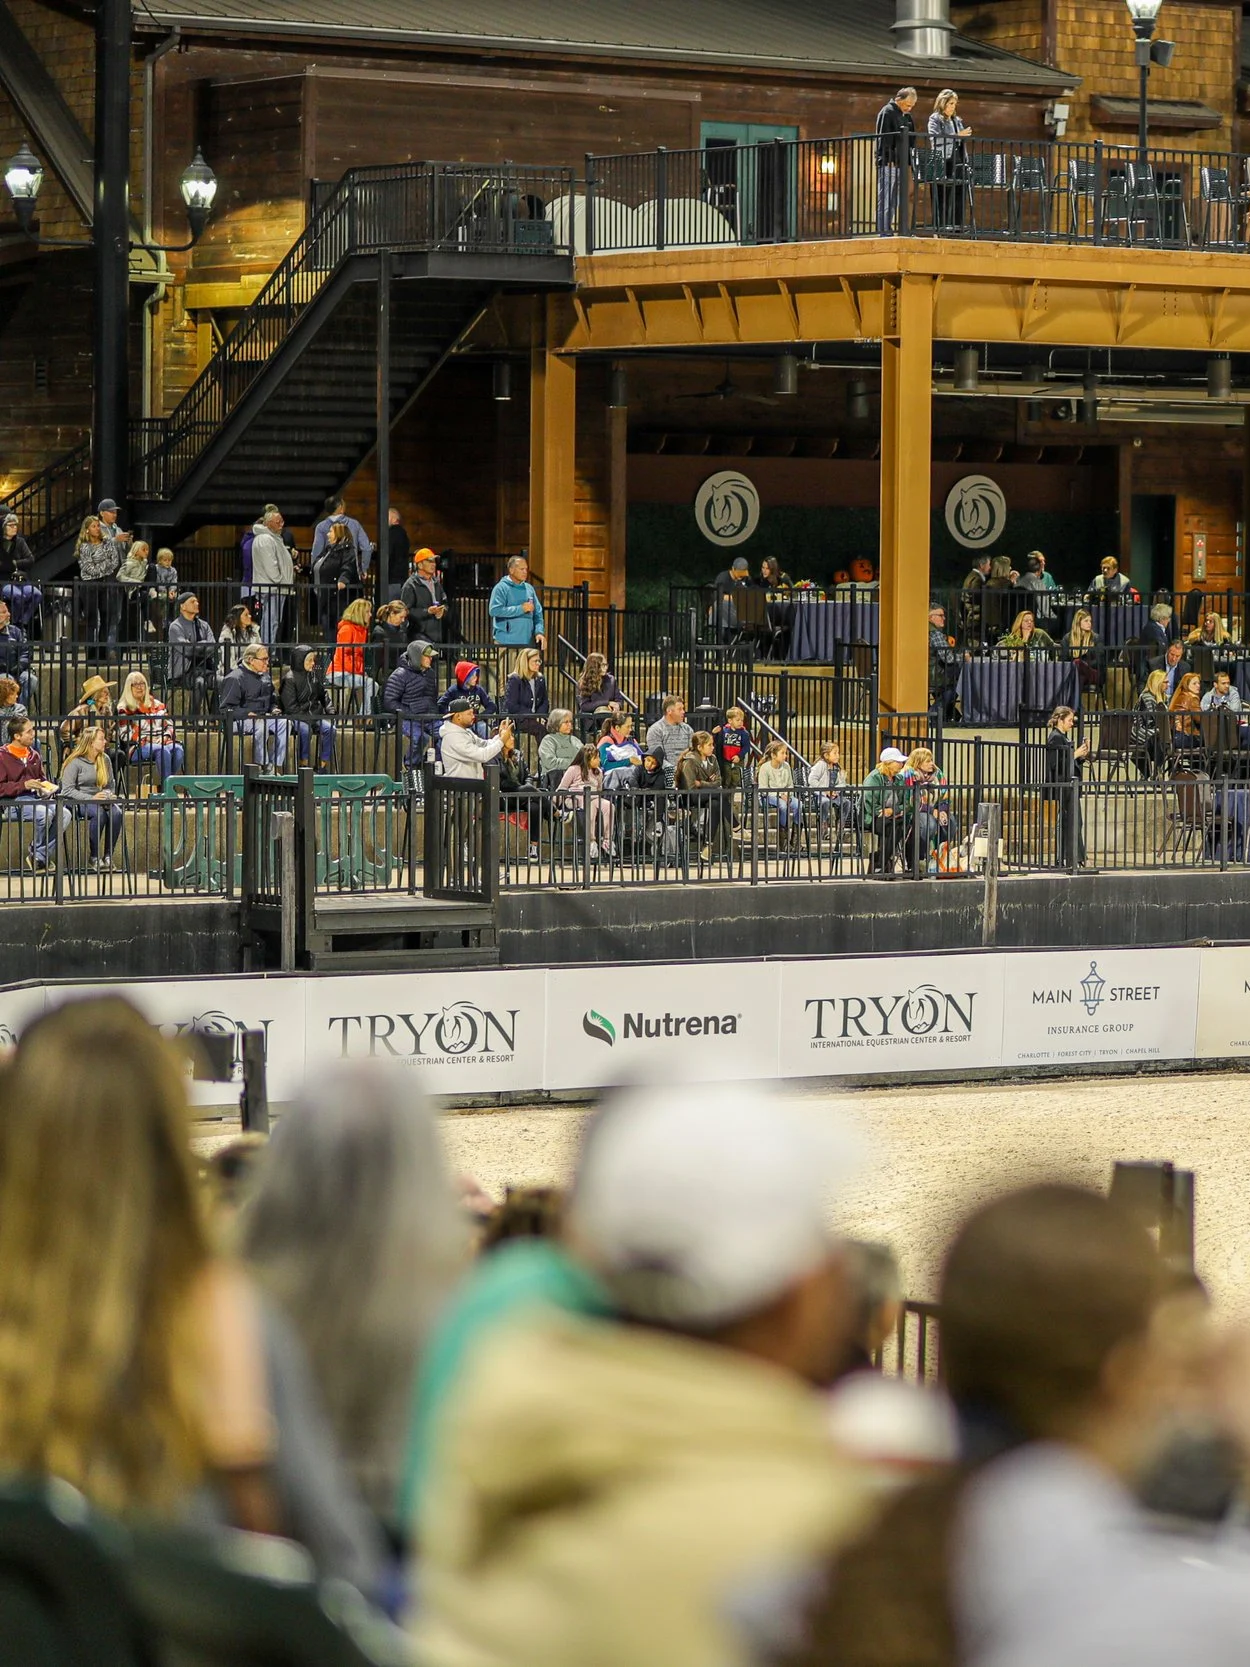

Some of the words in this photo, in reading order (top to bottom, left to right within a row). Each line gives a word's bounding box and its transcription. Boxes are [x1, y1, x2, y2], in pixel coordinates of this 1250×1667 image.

[1032, 990, 1072, 1004] MAIN
[1110, 987, 1160, 1001] STREET
[805, 984, 978, 1039] TRYON
[328, 1001, 520, 1058] TRYON
[1047, 1025, 1099, 1035] INSURANCE
[1102, 1023, 1134, 1033] GROUP
[810, 1040, 865, 1049] INTERNATIONAL
[866, 1037, 909, 1047] EQUESTRIAN
[911, 1036, 937, 1044] CENTER
[945, 1035, 971, 1043] RESORT
[446, 1055, 477, 1065] CENTER
[479, 1055, 485, 1063] &
[486, 1054, 514, 1063] RESORT
